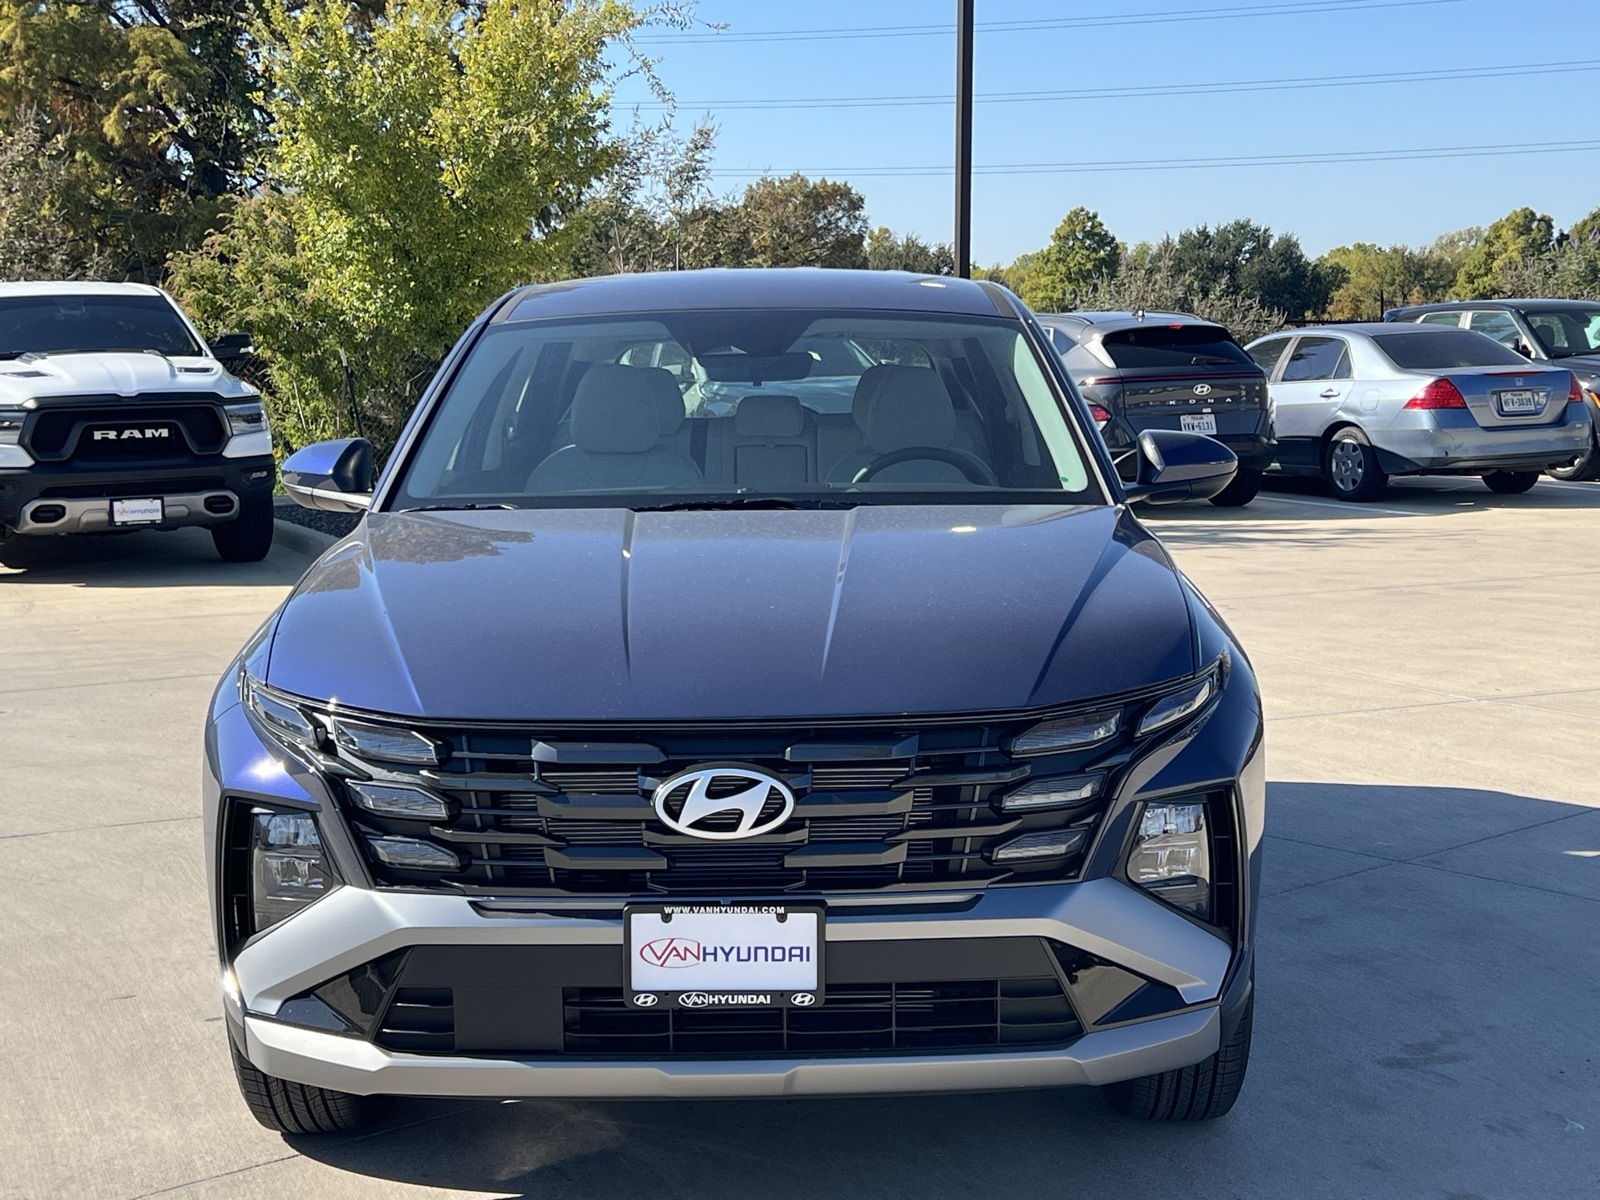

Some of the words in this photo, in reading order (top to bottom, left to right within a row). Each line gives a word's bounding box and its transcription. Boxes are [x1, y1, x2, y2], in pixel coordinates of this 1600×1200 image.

[1169, 397, 1232, 406] KONA
[93, 428, 169, 440] RAM
[664, 906, 785, 914] WWW.VANHYUNDAI.COM
